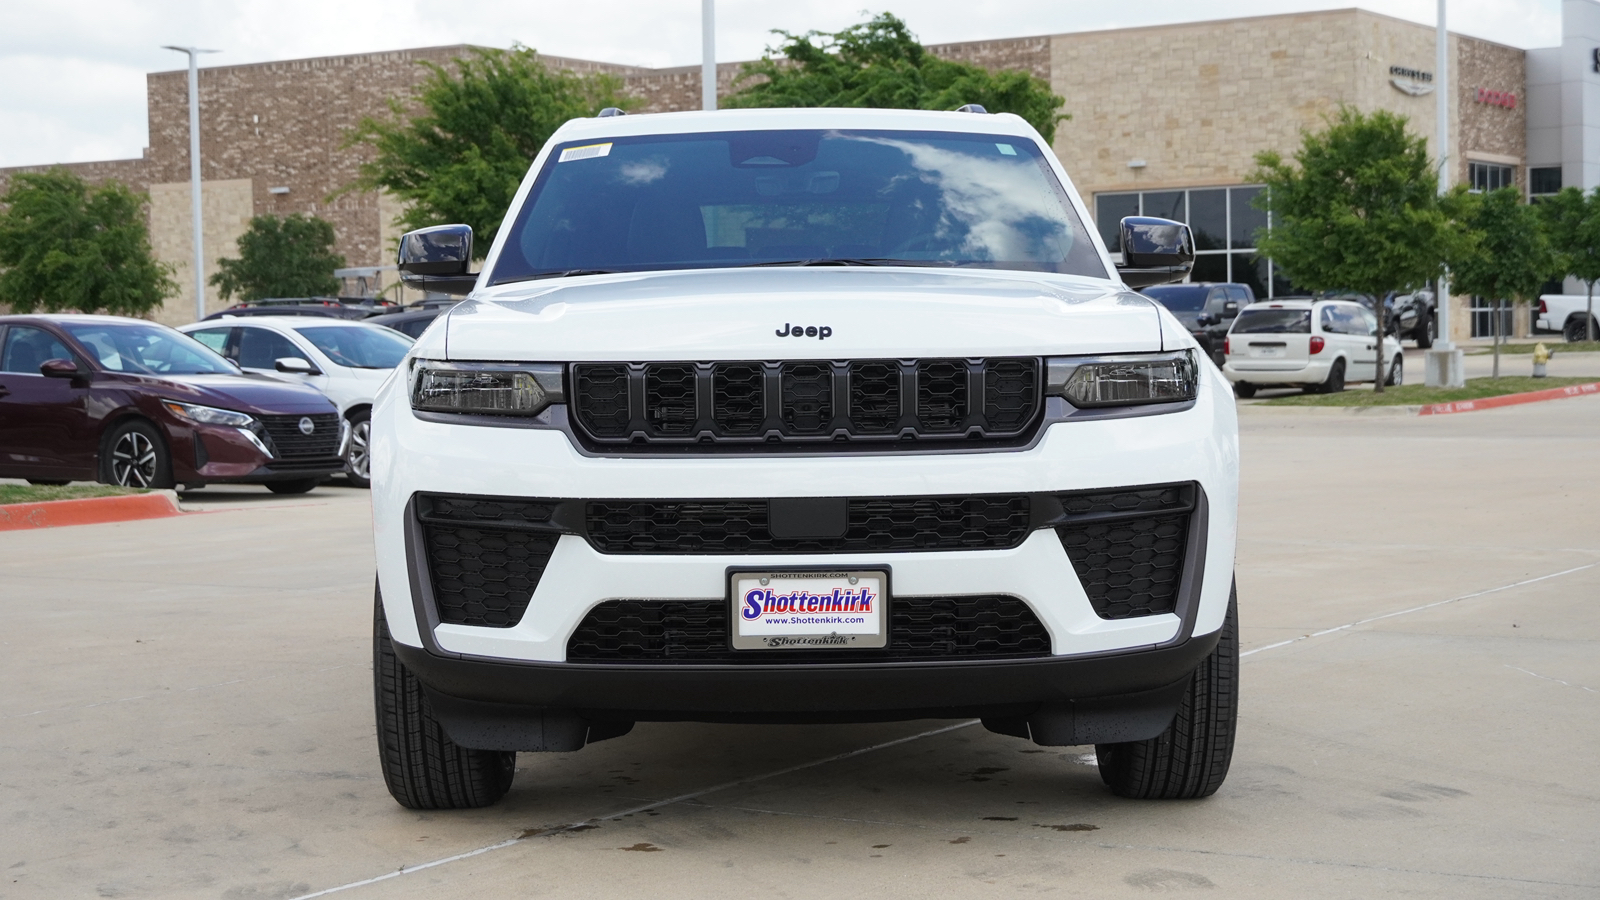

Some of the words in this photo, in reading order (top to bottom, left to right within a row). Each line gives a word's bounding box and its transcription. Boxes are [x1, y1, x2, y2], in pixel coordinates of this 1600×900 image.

[1477, 88, 1516, 108] DODGE
[775, 322, 833, 341] Jeep
[742, 588, 875, 620] Shottenkirk
[765, 616, 865, 625] www.Shottenkirk.com
